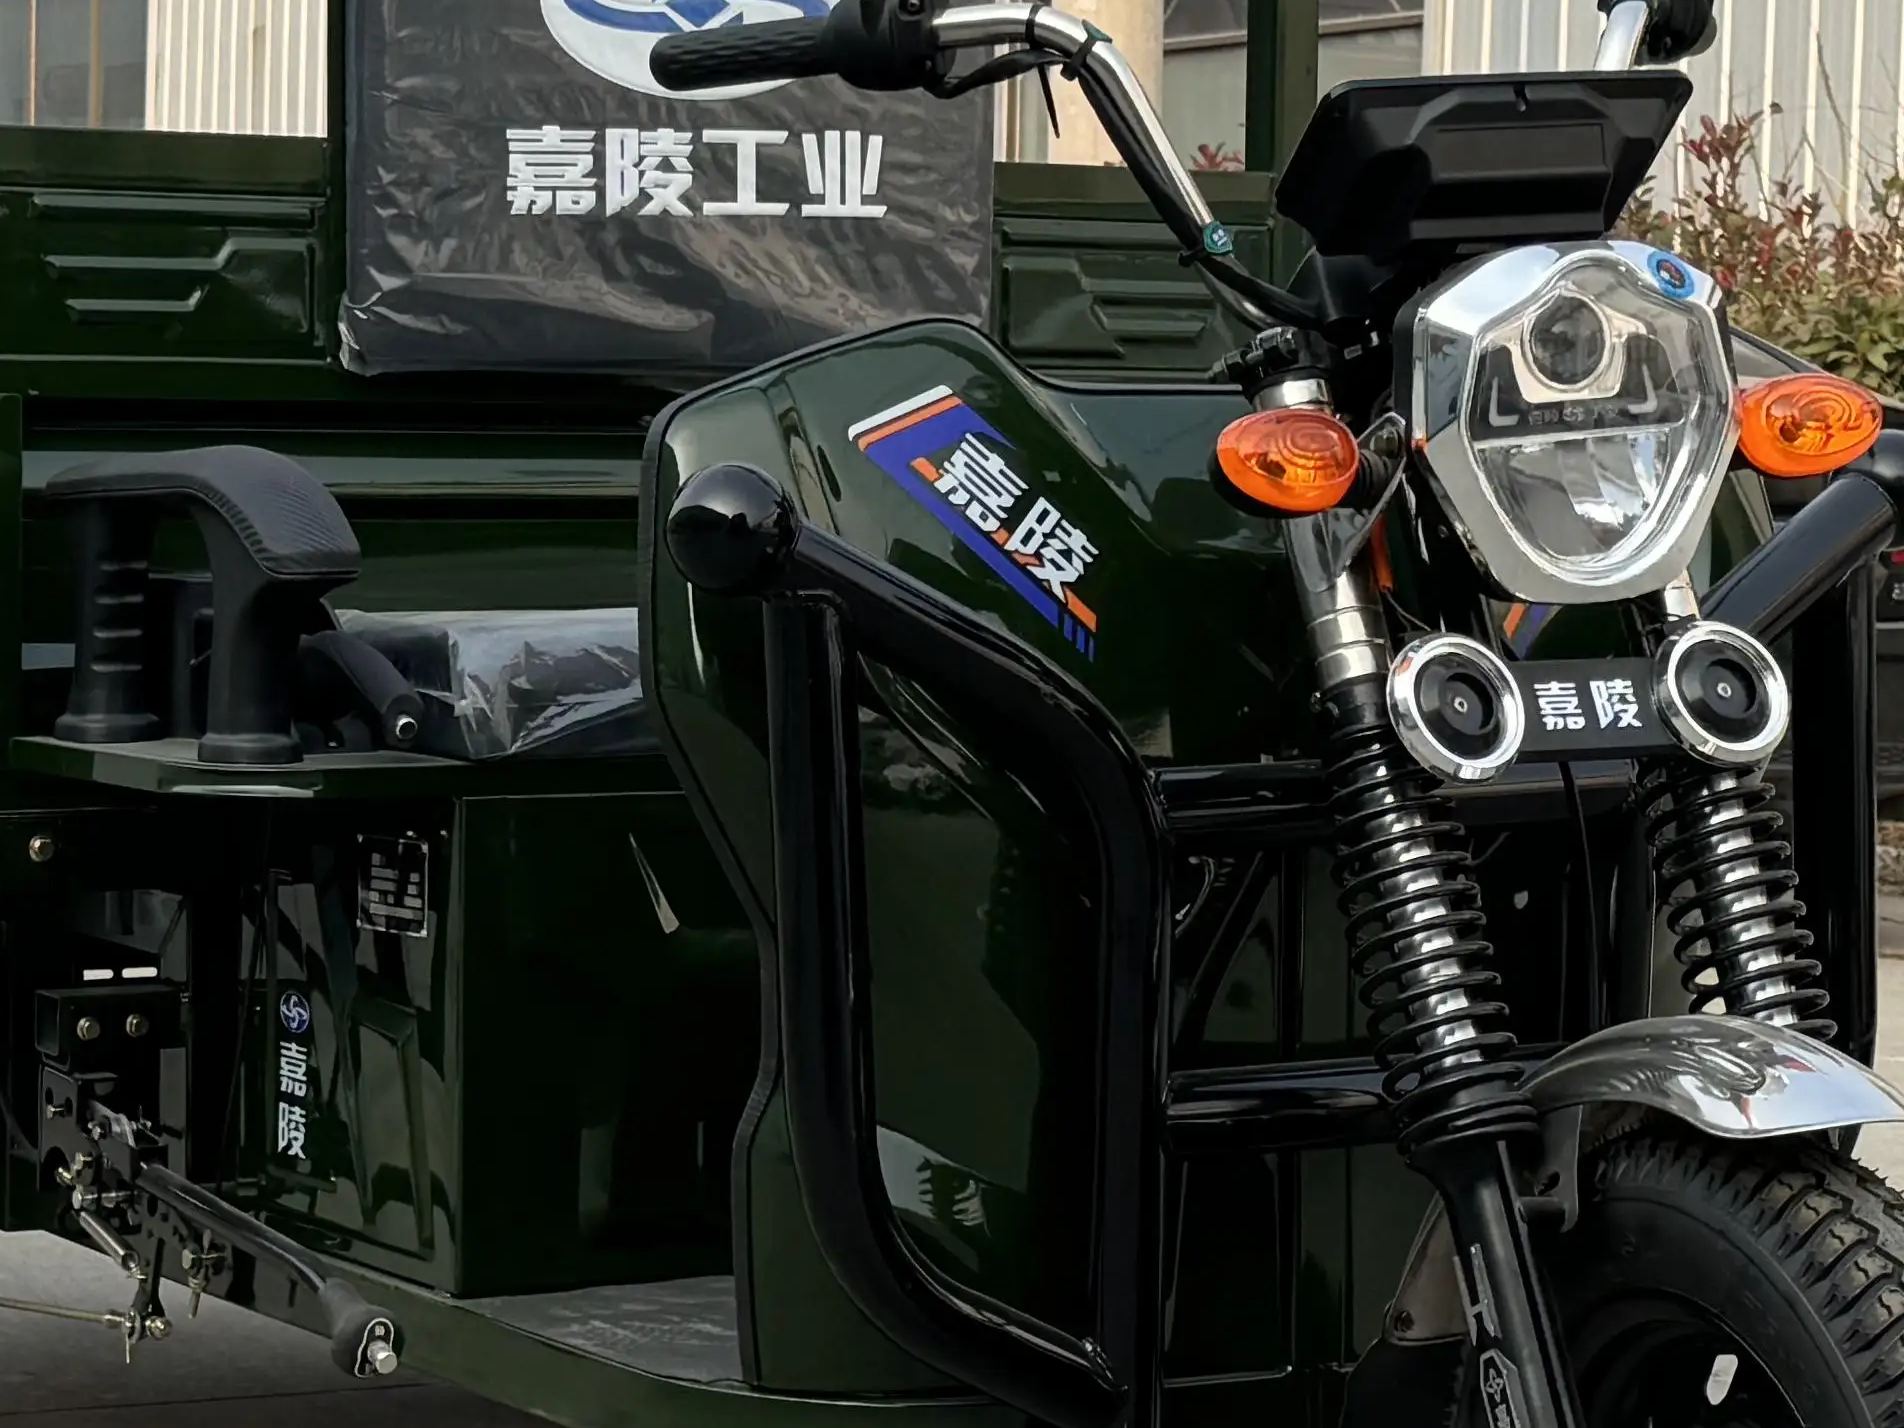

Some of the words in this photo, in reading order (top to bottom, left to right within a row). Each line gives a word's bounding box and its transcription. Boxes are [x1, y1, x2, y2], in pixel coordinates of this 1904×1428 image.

[506, 125, 888, 218] 嘉陵工业
[933, 432, 1100, 604] 嘉陵
[1533, 678, 1643, 731] 嘉陵
[277, 1041, 308, 1160] 嘉陵
